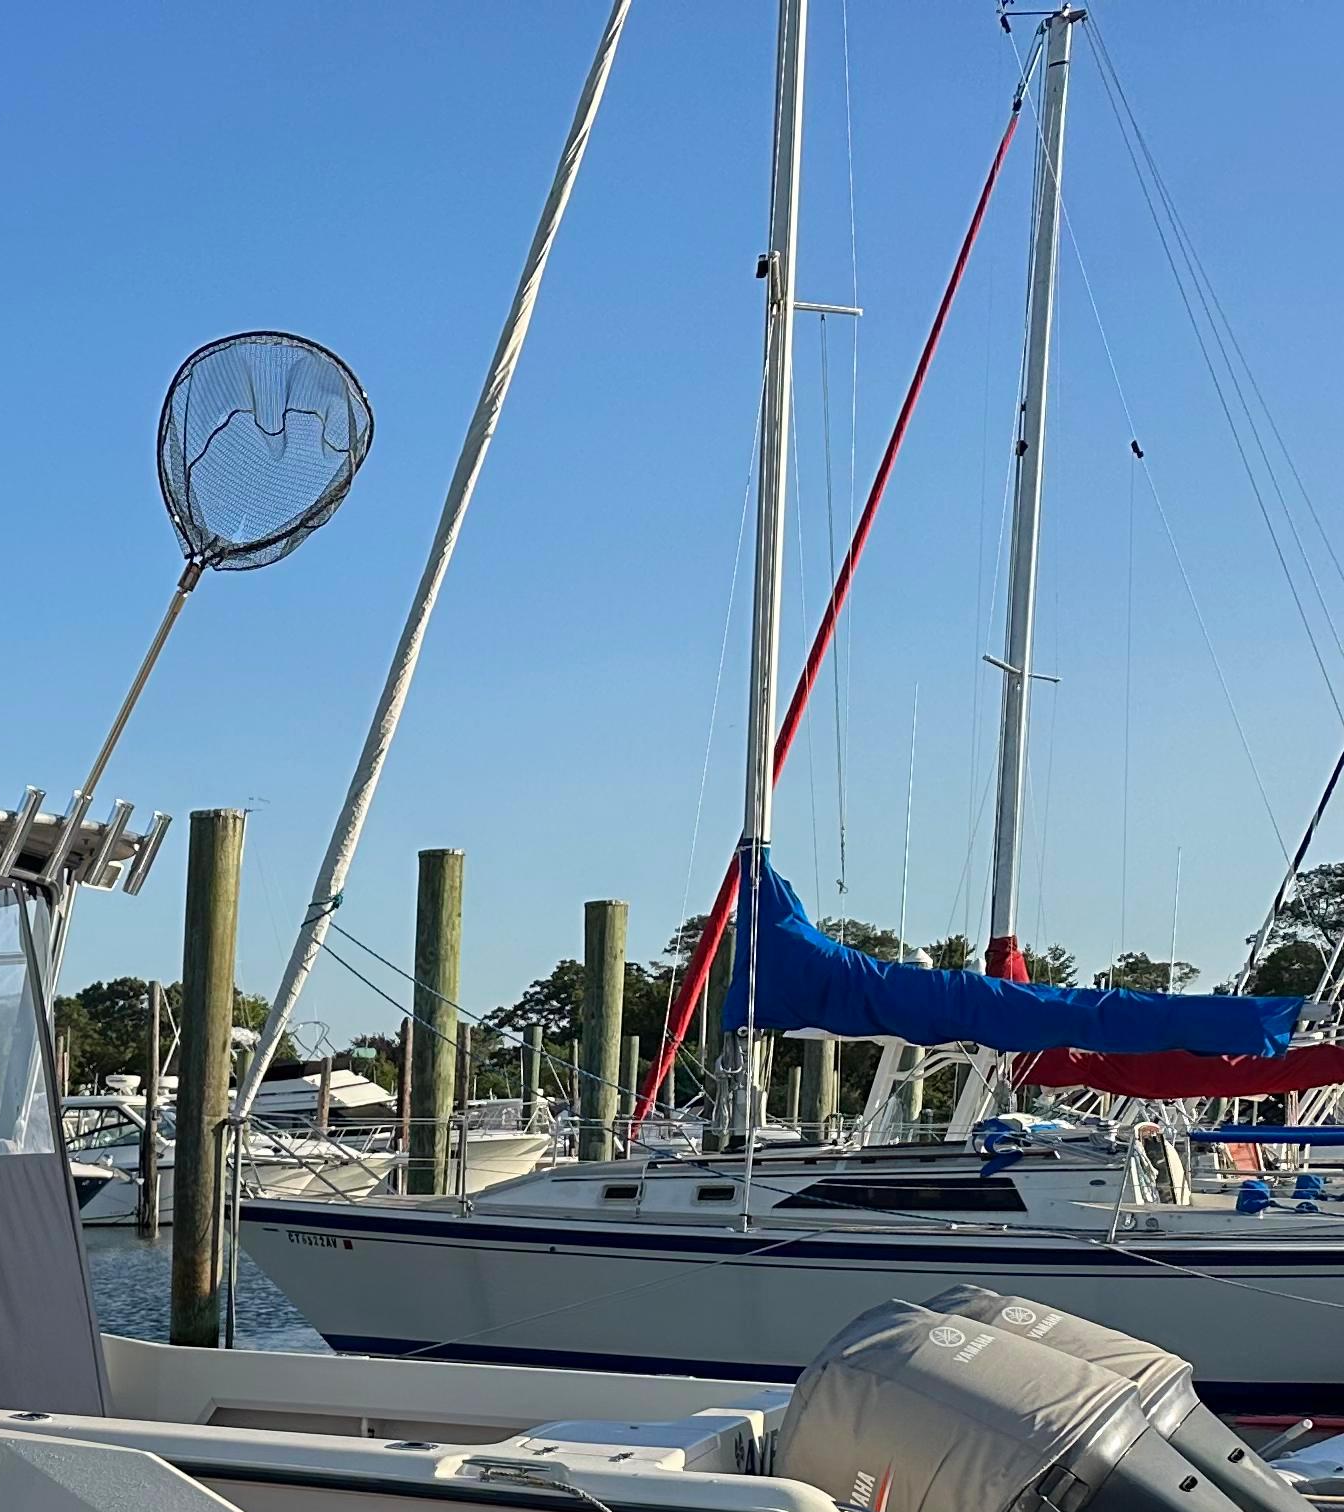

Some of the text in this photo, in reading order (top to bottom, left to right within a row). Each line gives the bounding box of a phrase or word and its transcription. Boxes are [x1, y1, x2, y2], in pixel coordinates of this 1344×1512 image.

[1026, 1313, 1064, 1339] YAMAHA
[953, 1333, 997, 1363] YAMAHA
[849, 1470, 876, 1508] AHA
